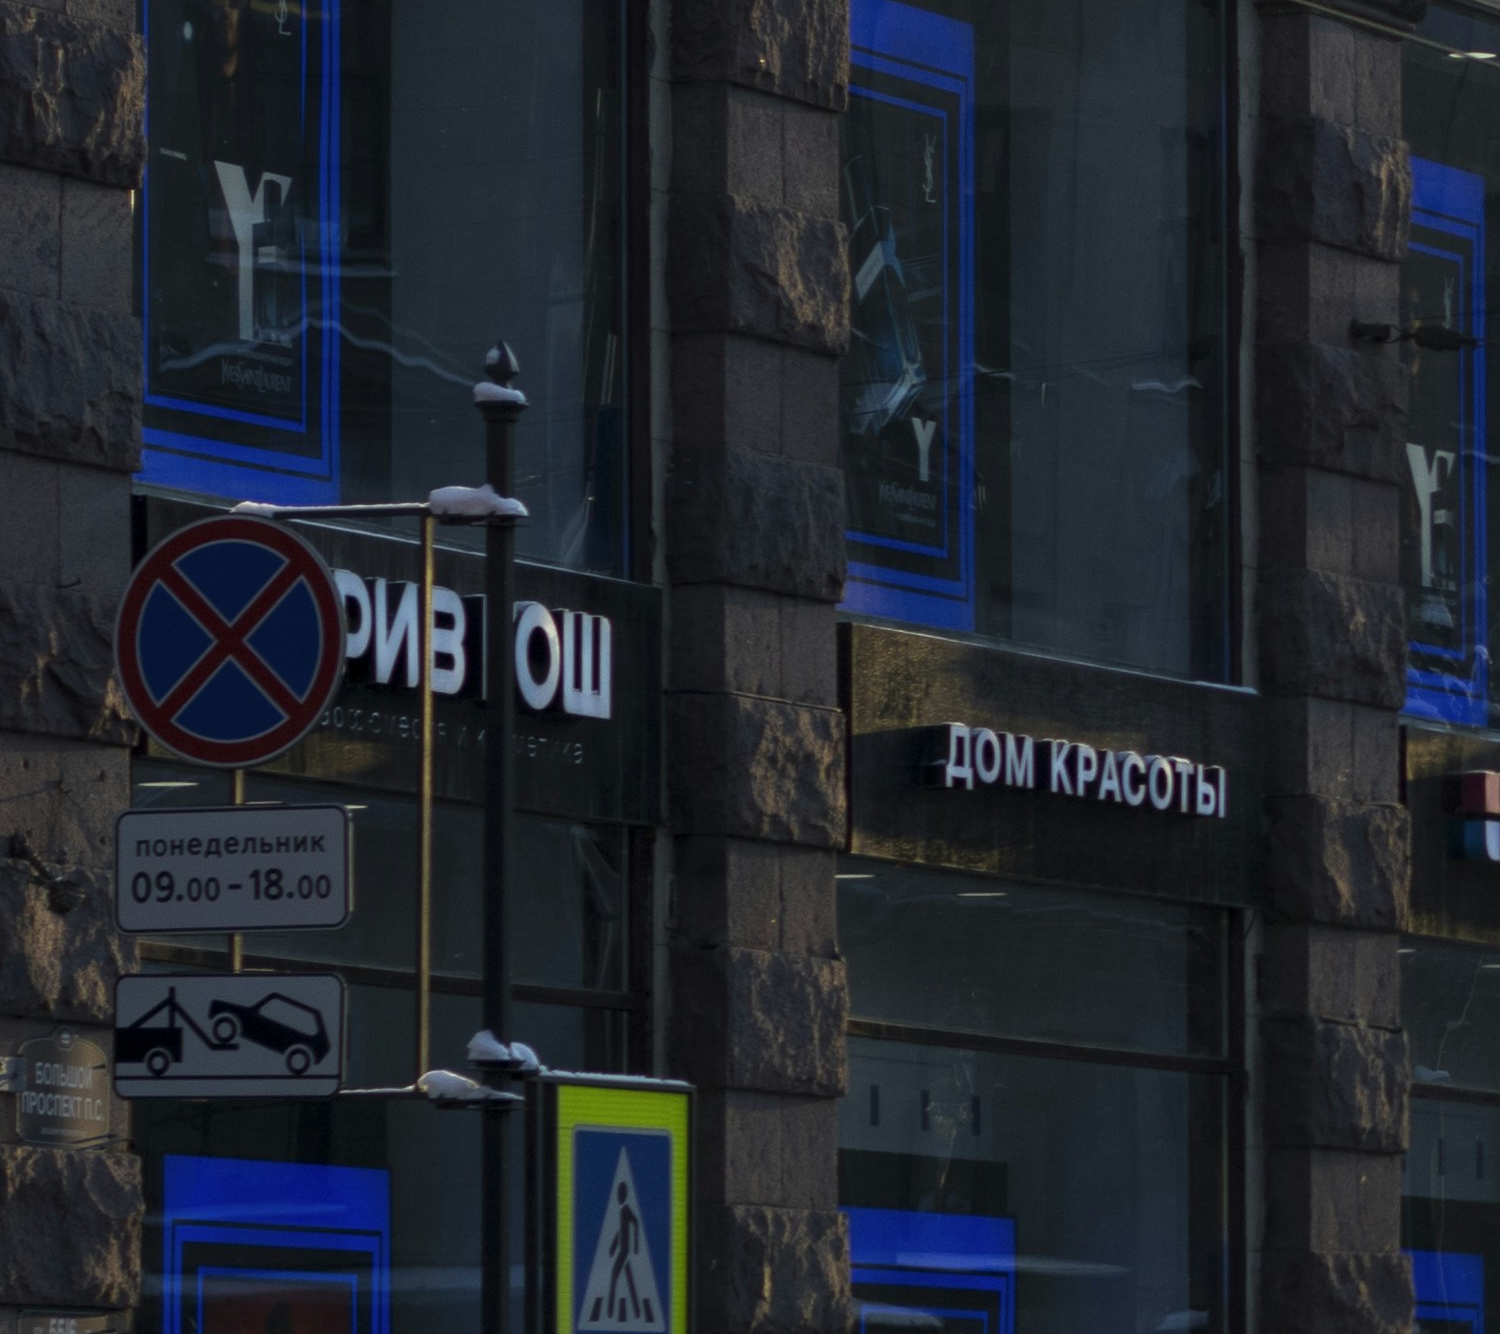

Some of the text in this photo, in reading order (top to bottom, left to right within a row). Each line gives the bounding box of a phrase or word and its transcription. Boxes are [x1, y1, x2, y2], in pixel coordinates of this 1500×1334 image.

[334, 569, 612, 720] РИВ ОШ
[945, 724, 1226, 818] ДОМ КРАСОТЫ
[136, 835, 326, 858] понедельник
[22, 1091, 82, 1118] ПРОСПЕКТ
